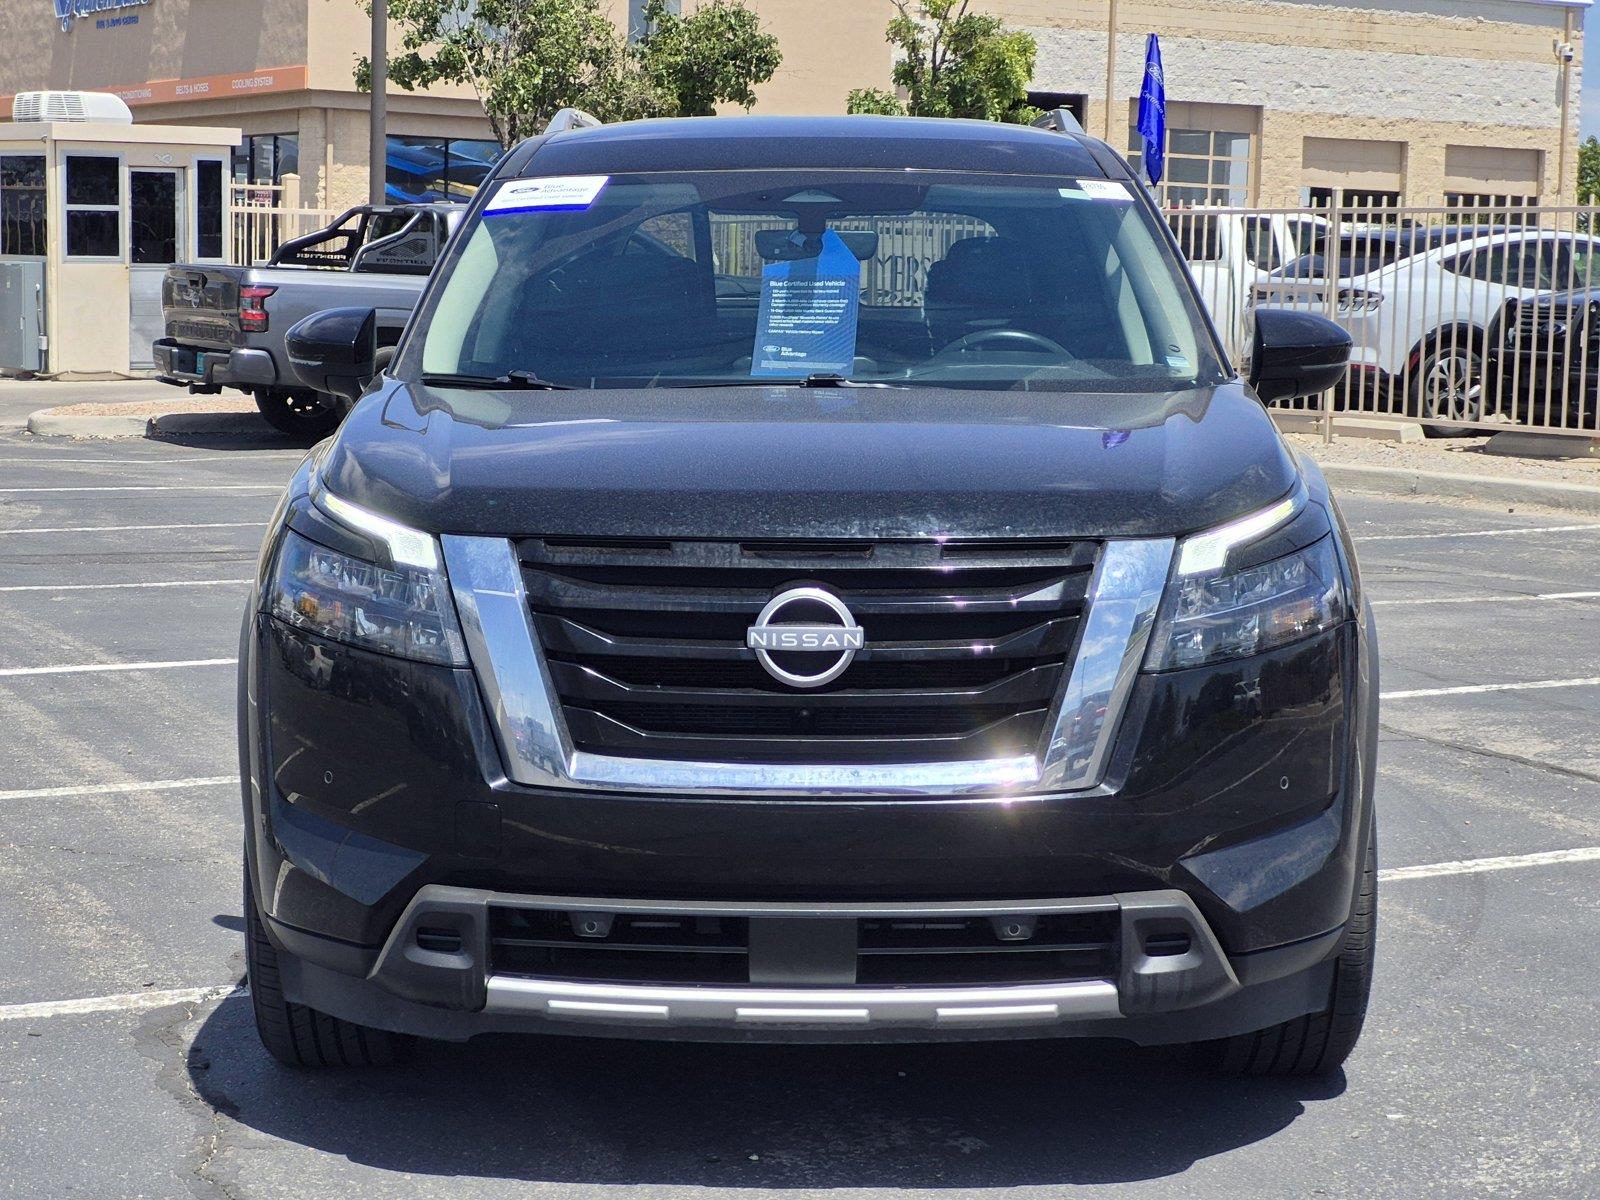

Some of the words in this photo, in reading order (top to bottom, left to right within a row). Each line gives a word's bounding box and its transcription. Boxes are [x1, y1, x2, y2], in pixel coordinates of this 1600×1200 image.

[194, 82, 209, 92] HOSES
[232, 78, 254, 89] COOLING
[254, 76, 273, 87] SYSTEM
[750, 632, 861, 647] NISSAN
